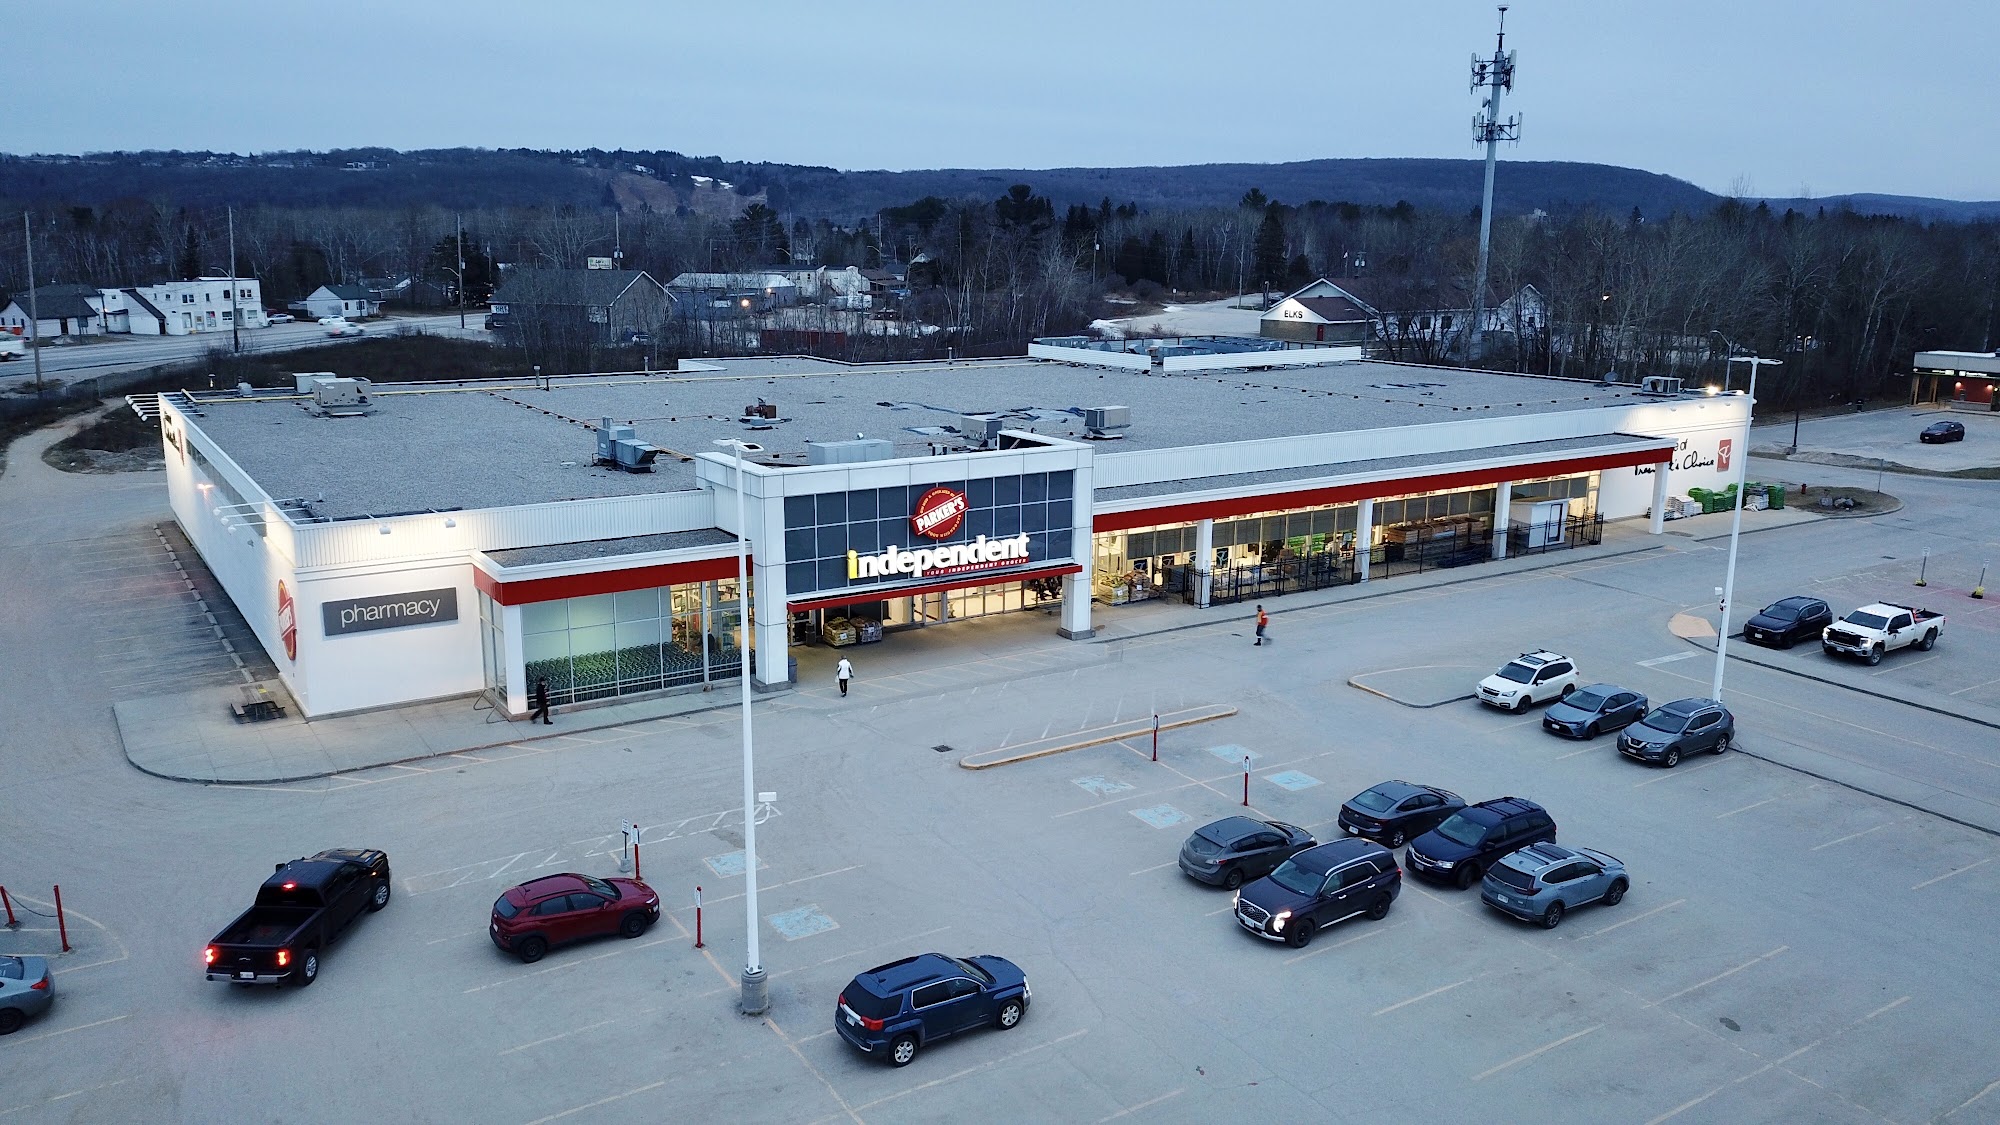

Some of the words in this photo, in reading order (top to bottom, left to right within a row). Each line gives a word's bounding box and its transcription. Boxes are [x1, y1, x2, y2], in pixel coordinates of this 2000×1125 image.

[1284, 309, 1303, 319] ELKS
[1683, 451, 1715, 470] Choice
[915, 496, 965, 532] PARKER'S
[847, 532, 1030, 580] independent
[948, 561, 998, 574] INDEPENDENT
[340, 598, 441, 628] pharmacy
